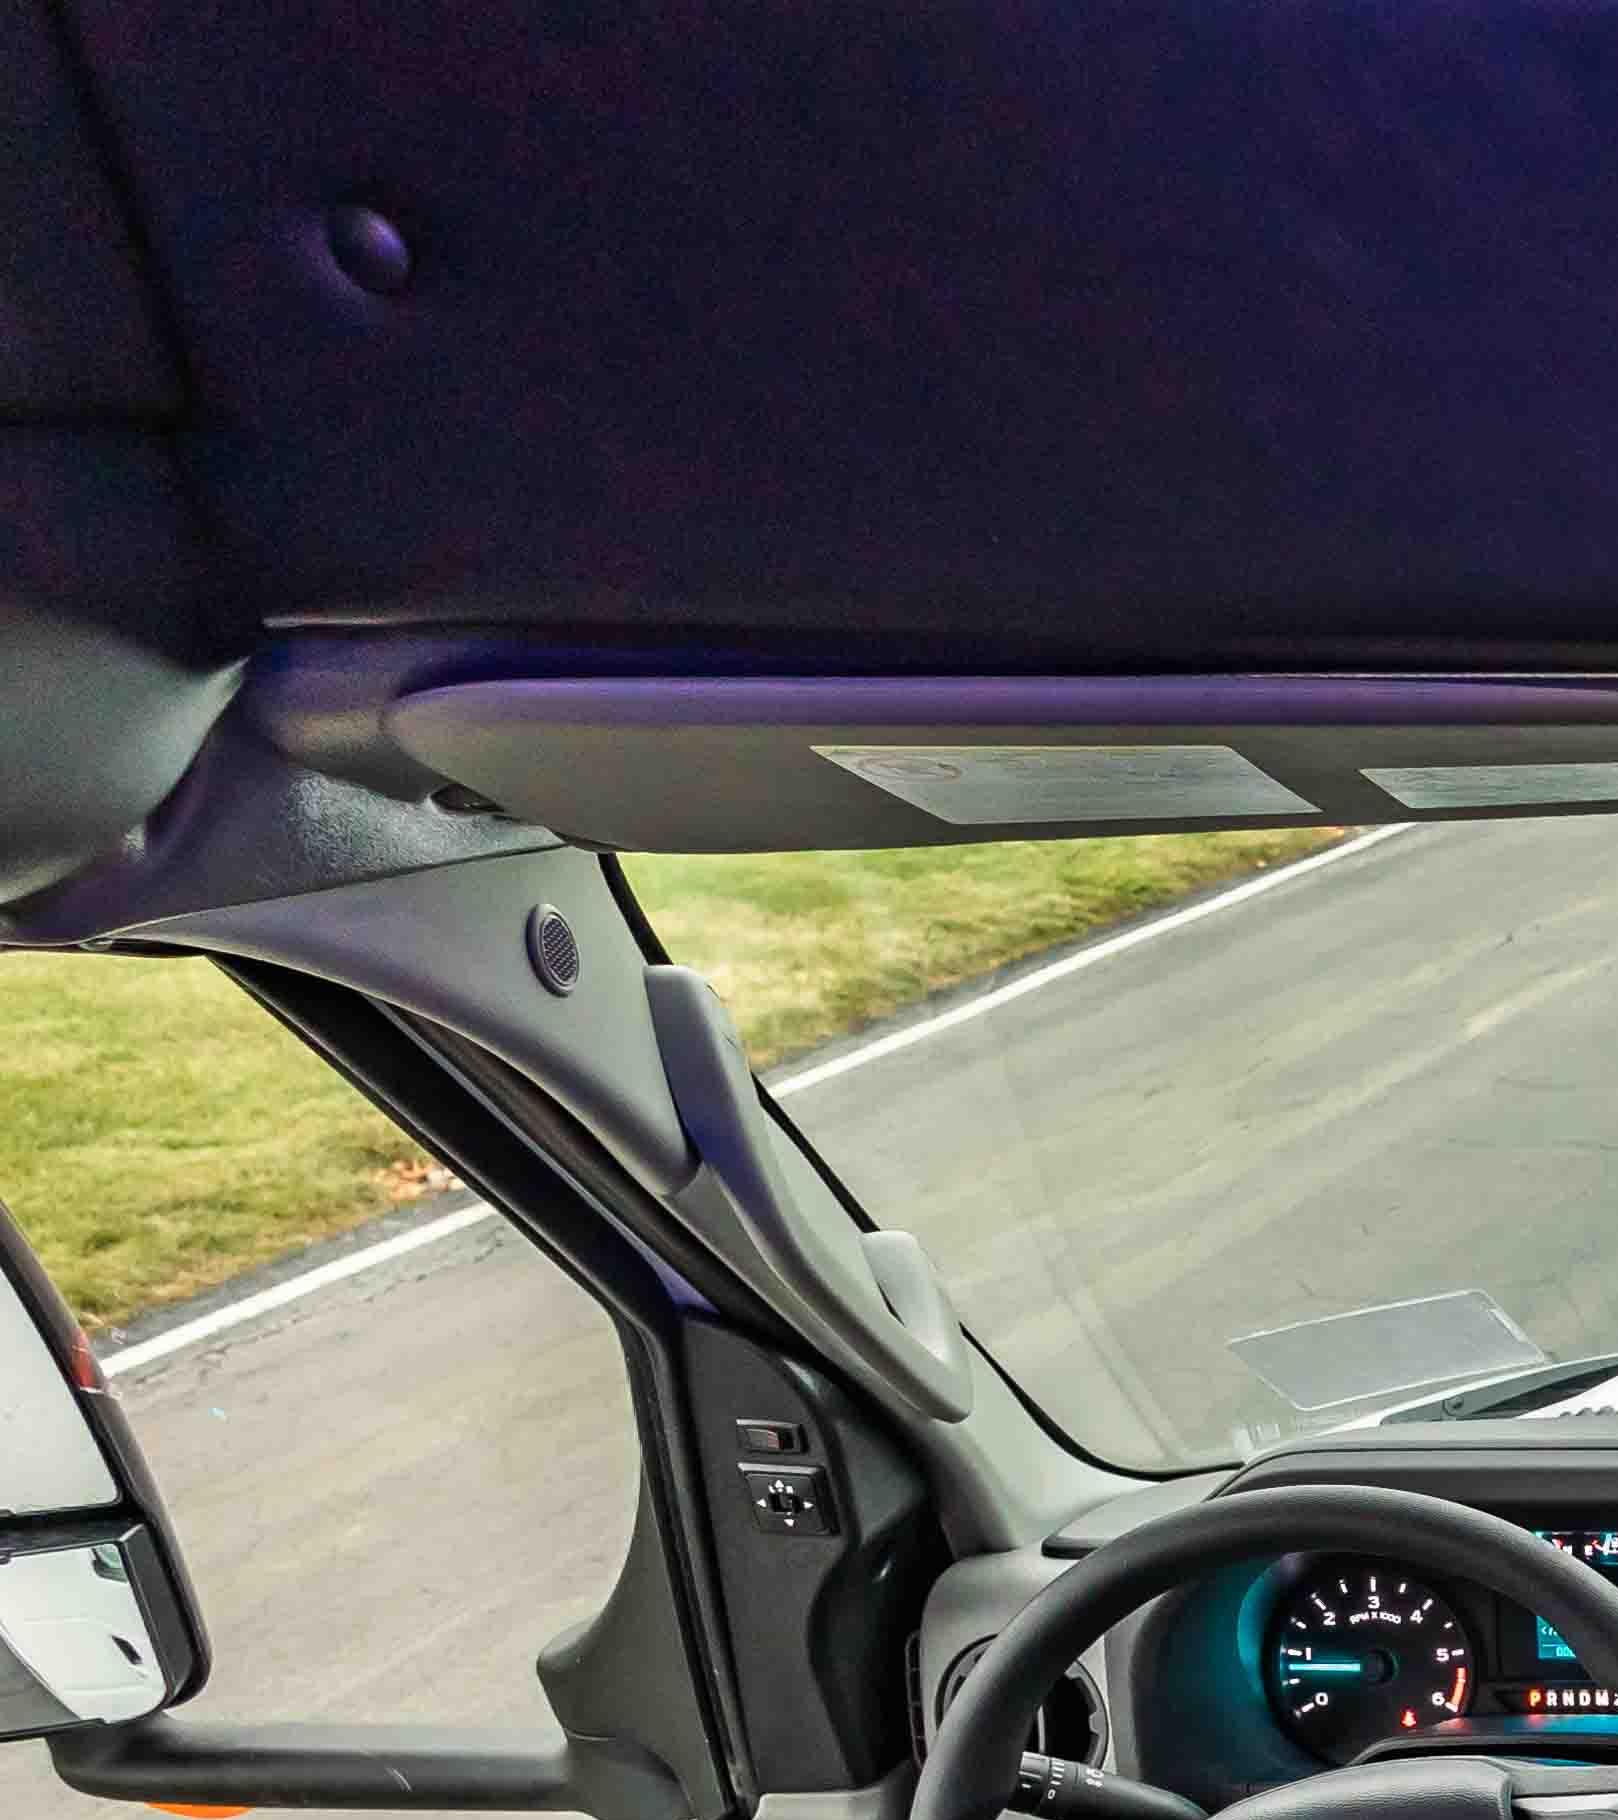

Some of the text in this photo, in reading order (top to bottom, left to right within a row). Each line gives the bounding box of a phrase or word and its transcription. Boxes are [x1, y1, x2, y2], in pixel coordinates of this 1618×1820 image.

[1368, 1596, 1380, 1609] 3
[1323, 1612, 1336, 1625] 2
[1410, 1610, 1423, 1624] 4
[1436, 1648, 1449, 1661] 5
[1315, 1692, 1328, 1705] 0
[1432, 1692, 1445, 1705] 6
